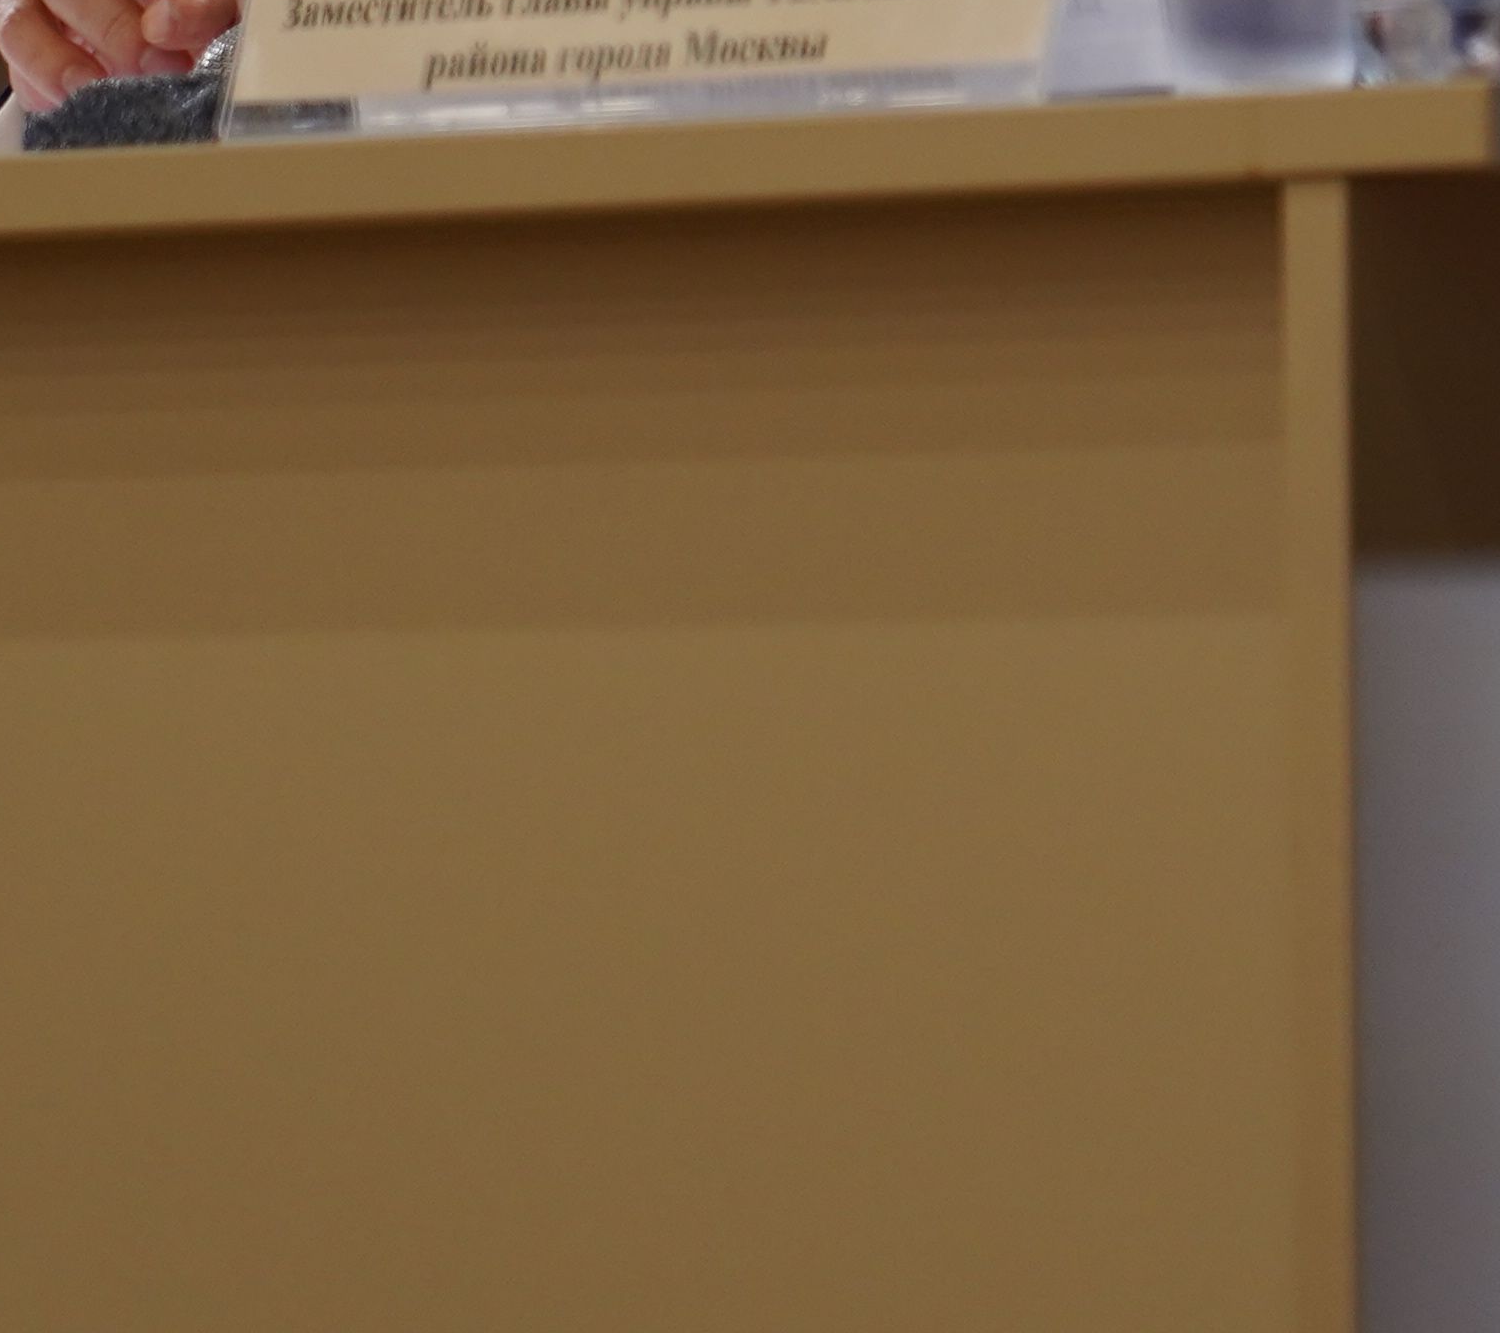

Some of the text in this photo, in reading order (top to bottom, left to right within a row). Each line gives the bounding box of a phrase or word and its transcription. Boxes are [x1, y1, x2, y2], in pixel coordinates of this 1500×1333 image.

[421, 41, 547, 91] района
[556, 40, 672, 82] города
[684, 30, 829, 69] Москвы
